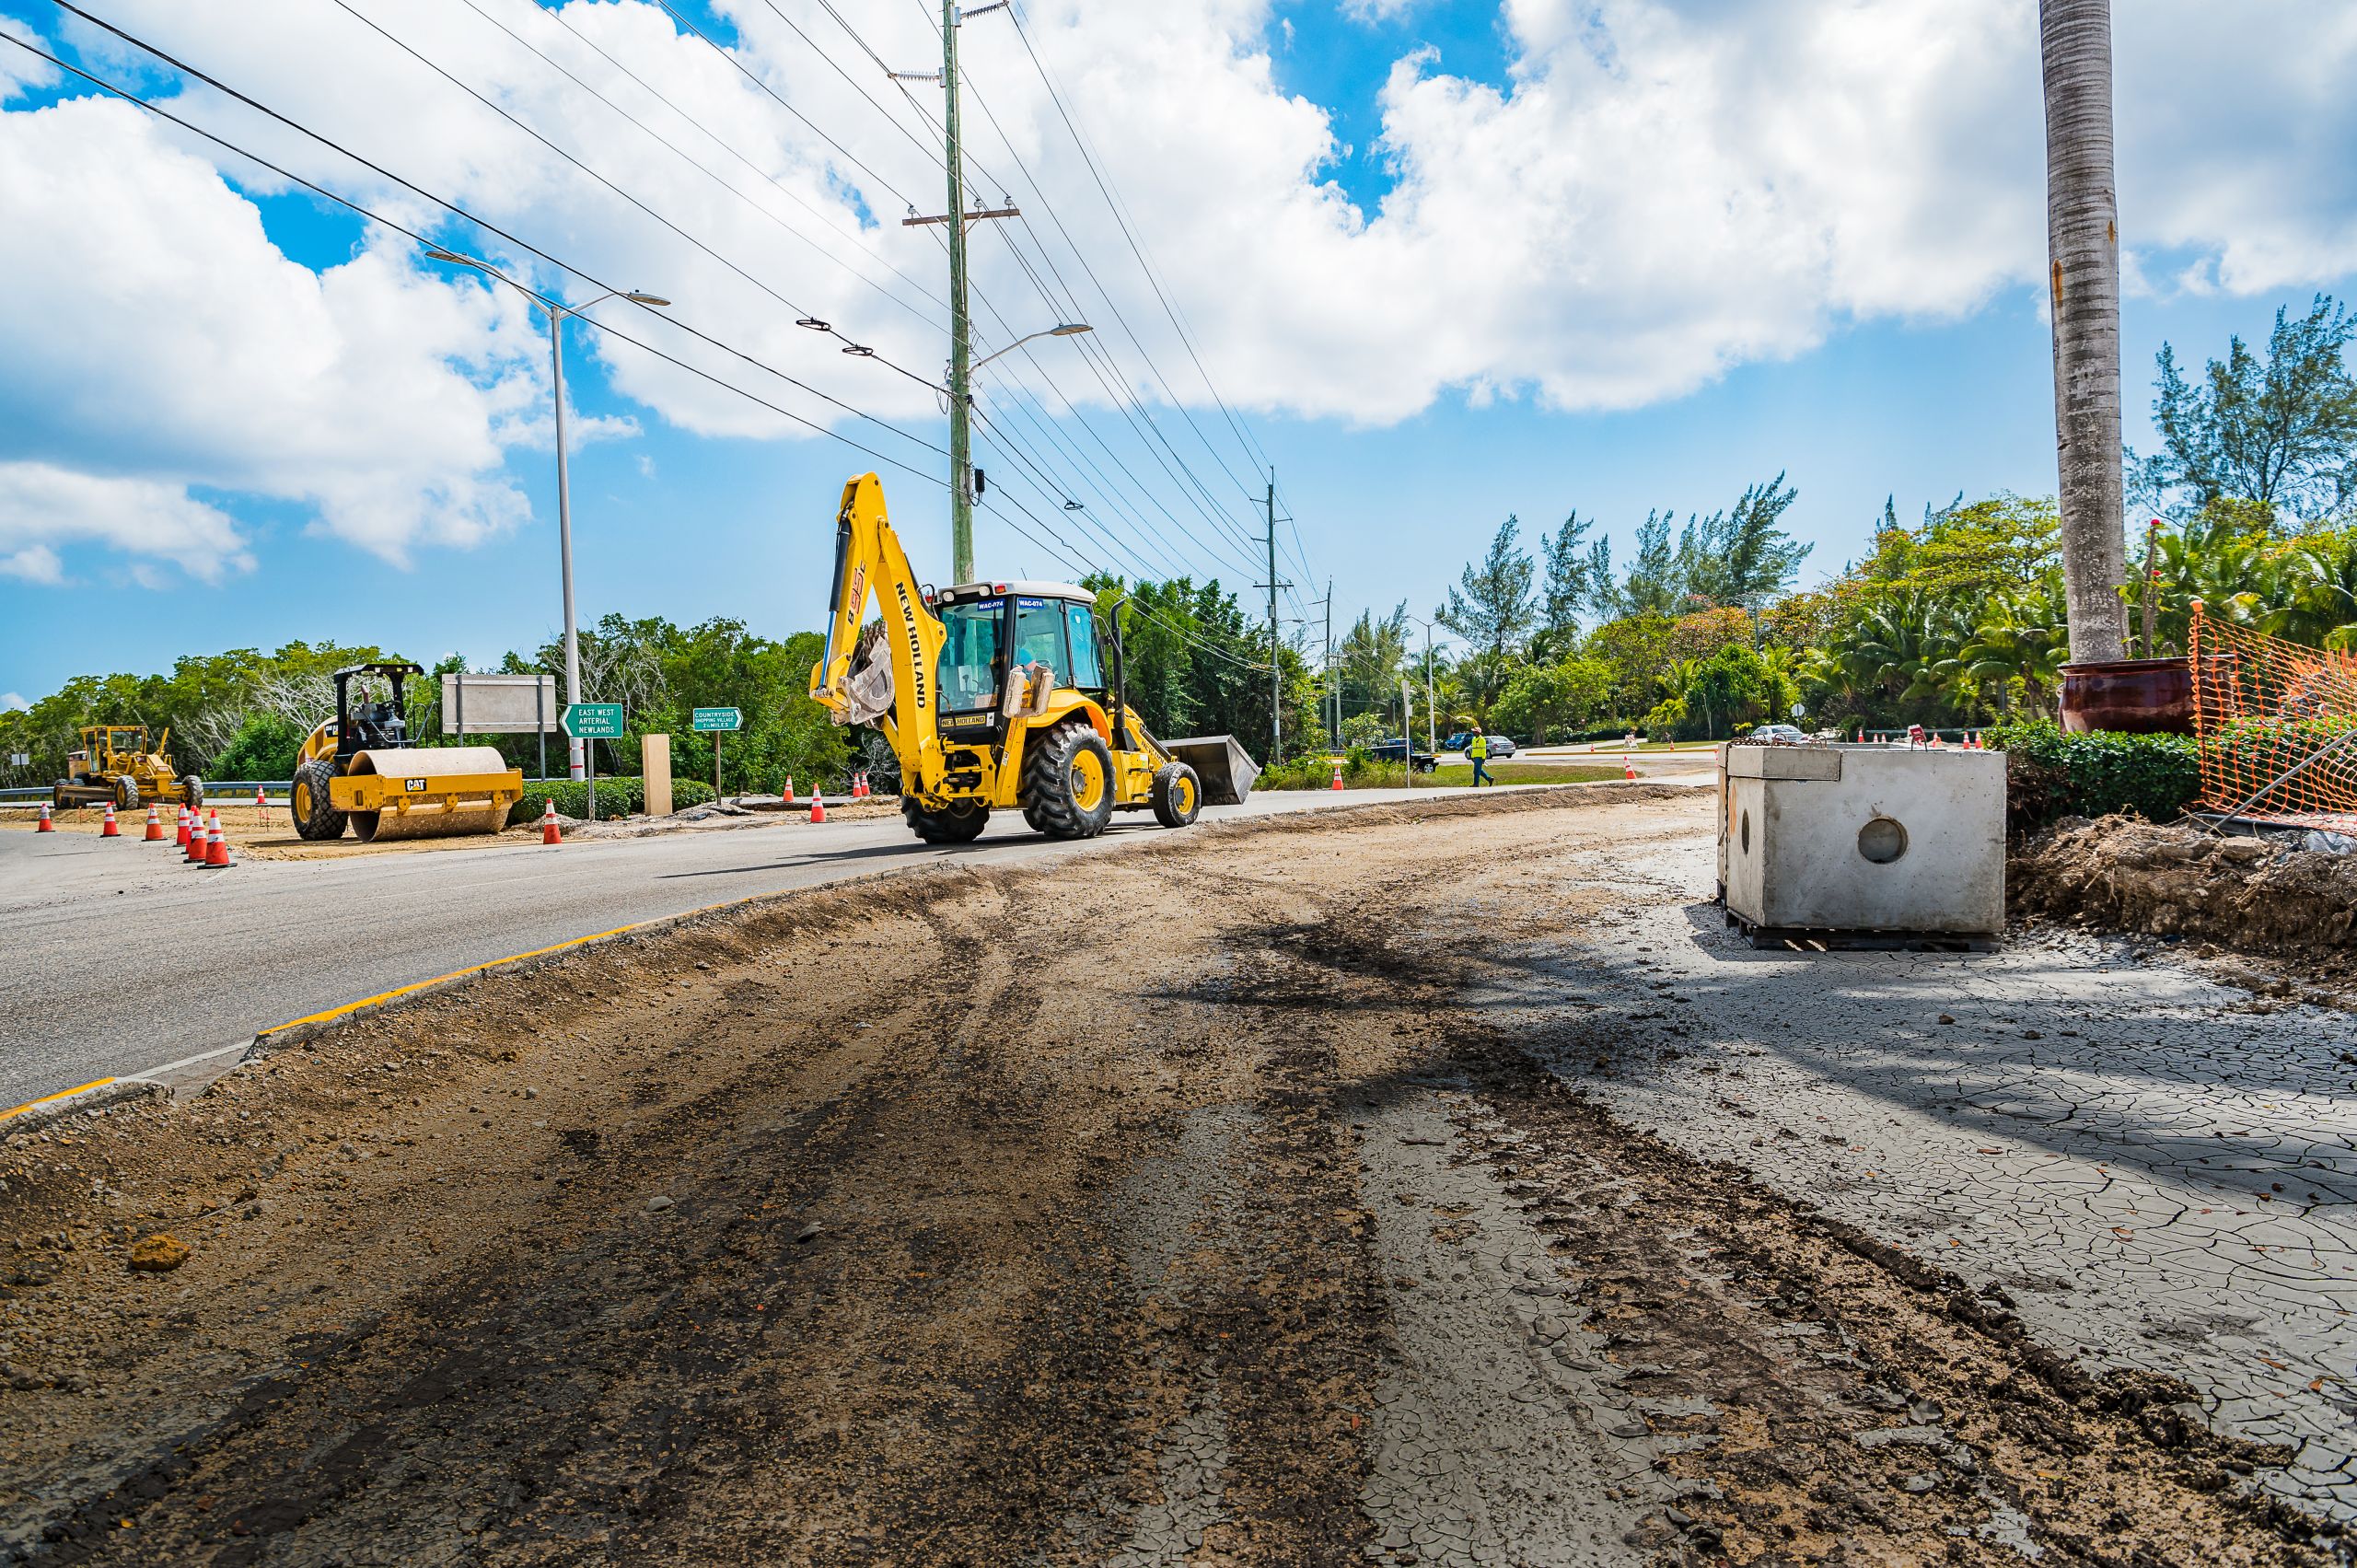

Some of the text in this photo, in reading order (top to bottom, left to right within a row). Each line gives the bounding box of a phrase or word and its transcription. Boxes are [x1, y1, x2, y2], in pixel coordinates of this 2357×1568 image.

[979, 600, 1004, 610] WAC-074
[896, 582, 925, 709] NEW HOLLAND
[578, 708, 615, 716] EAST WEST
[957, 716, 984, 726] HOLLAND
[578, 726, 615, 734] NEWLANDS
[407, 779, 424, 791] CAT
